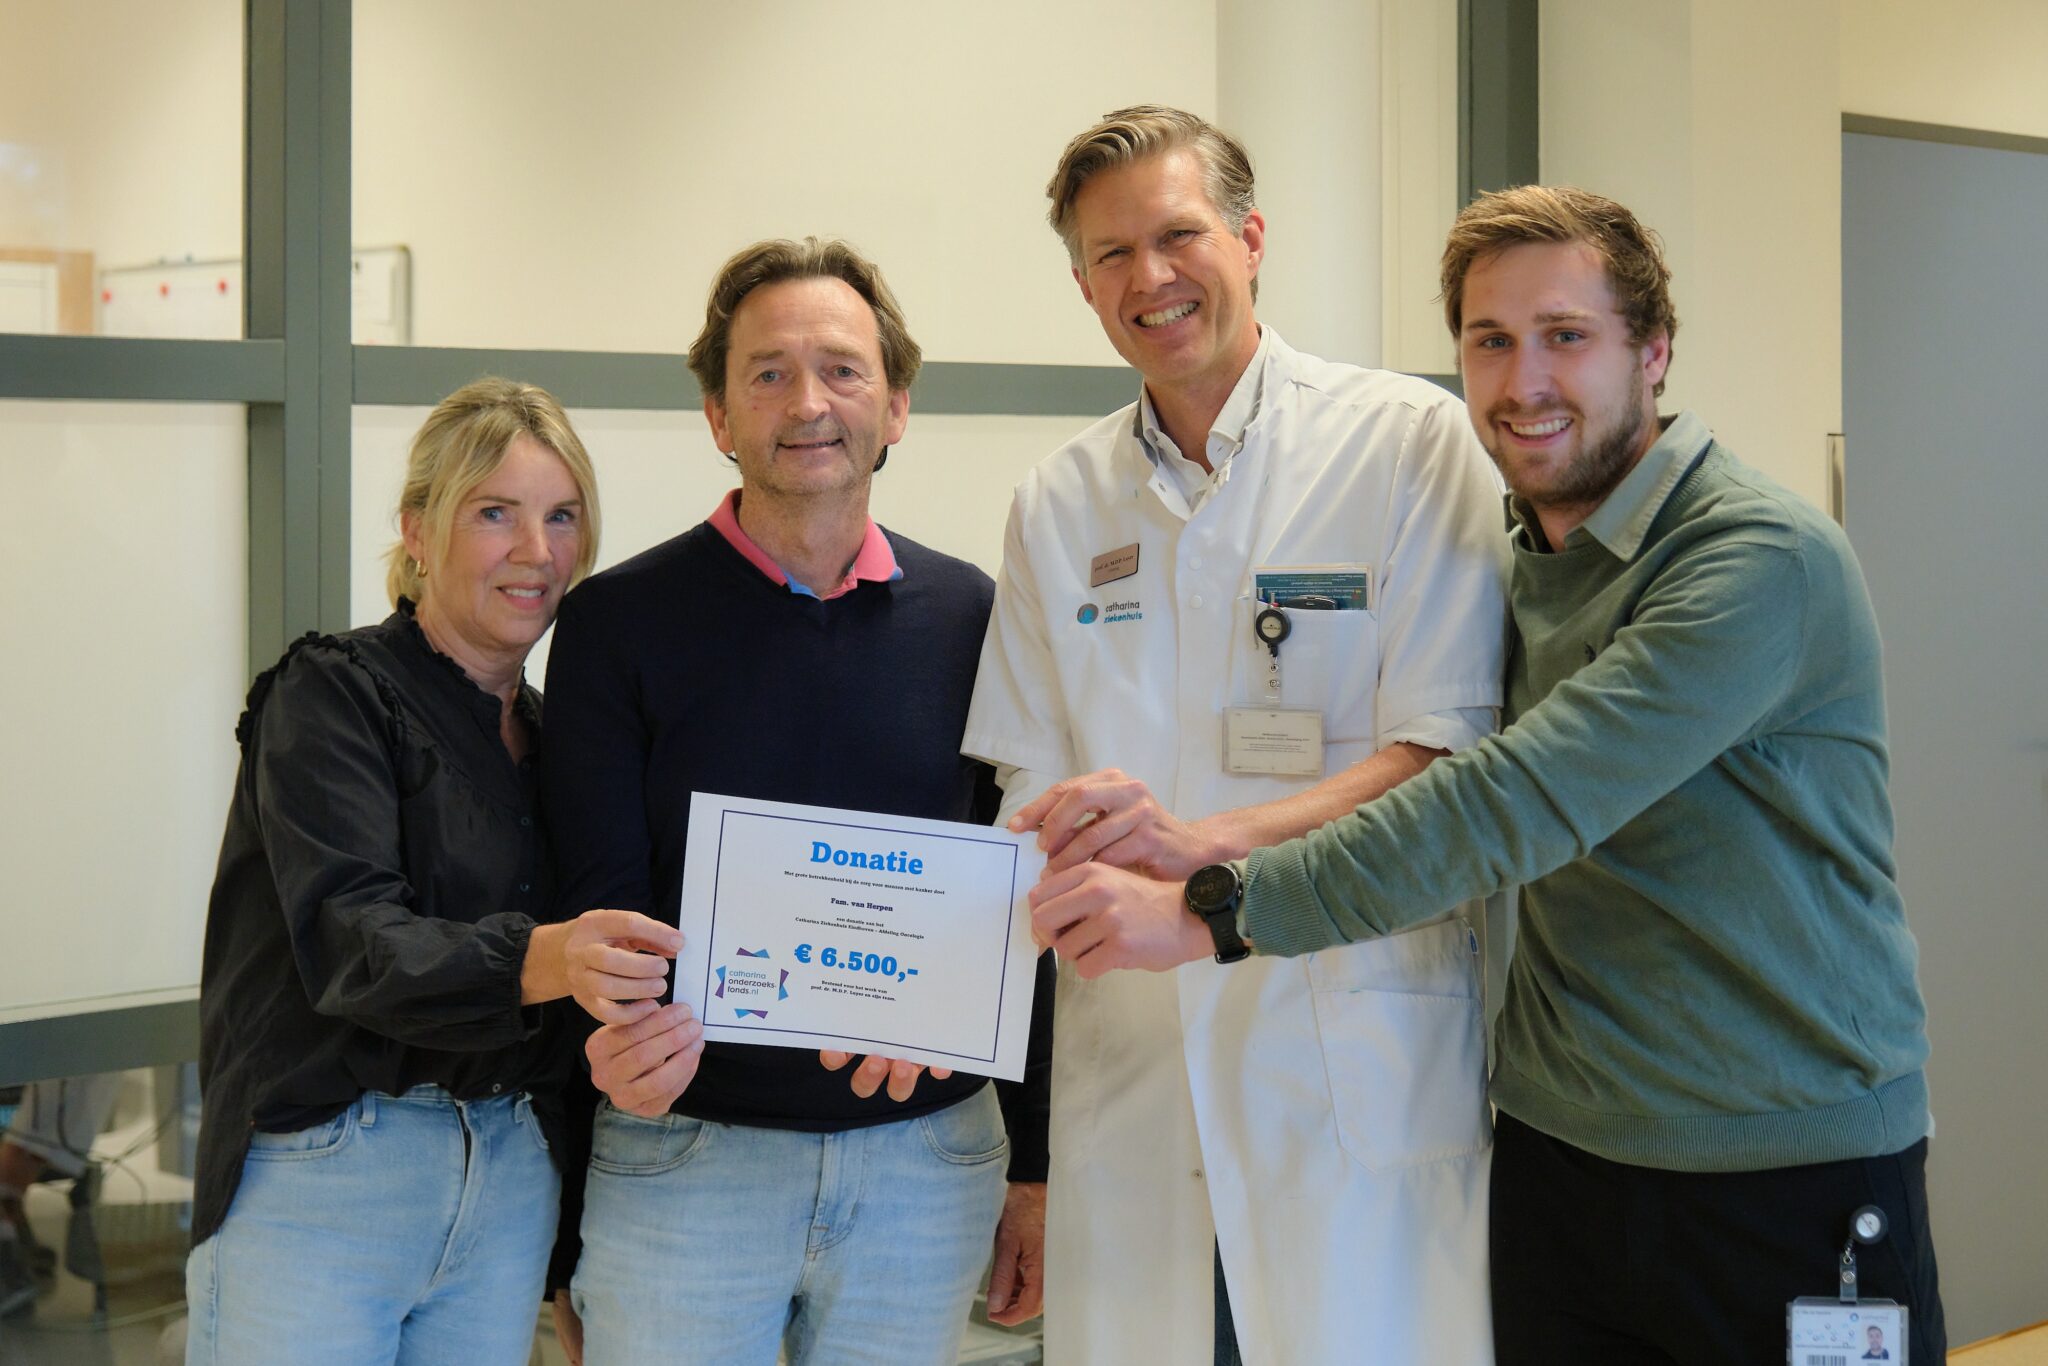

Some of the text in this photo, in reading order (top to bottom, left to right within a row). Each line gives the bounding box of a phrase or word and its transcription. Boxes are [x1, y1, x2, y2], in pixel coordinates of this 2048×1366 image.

[1105, 600, 1140, 613] catharina
[1103, 611, 1142, 623] ziekenhuis
[810, 841, 923, 875] Donatie
[830, 897, 849, 906] Fam.
[866, 902, 893, 912] Herpen
[794, 943, 919, 982] € 6.500,-
[729, 970, 767, 979] catharina
[728, 978, 777, 988] onderzoeks-
[727, 986, 759, 995] fonds.nl
